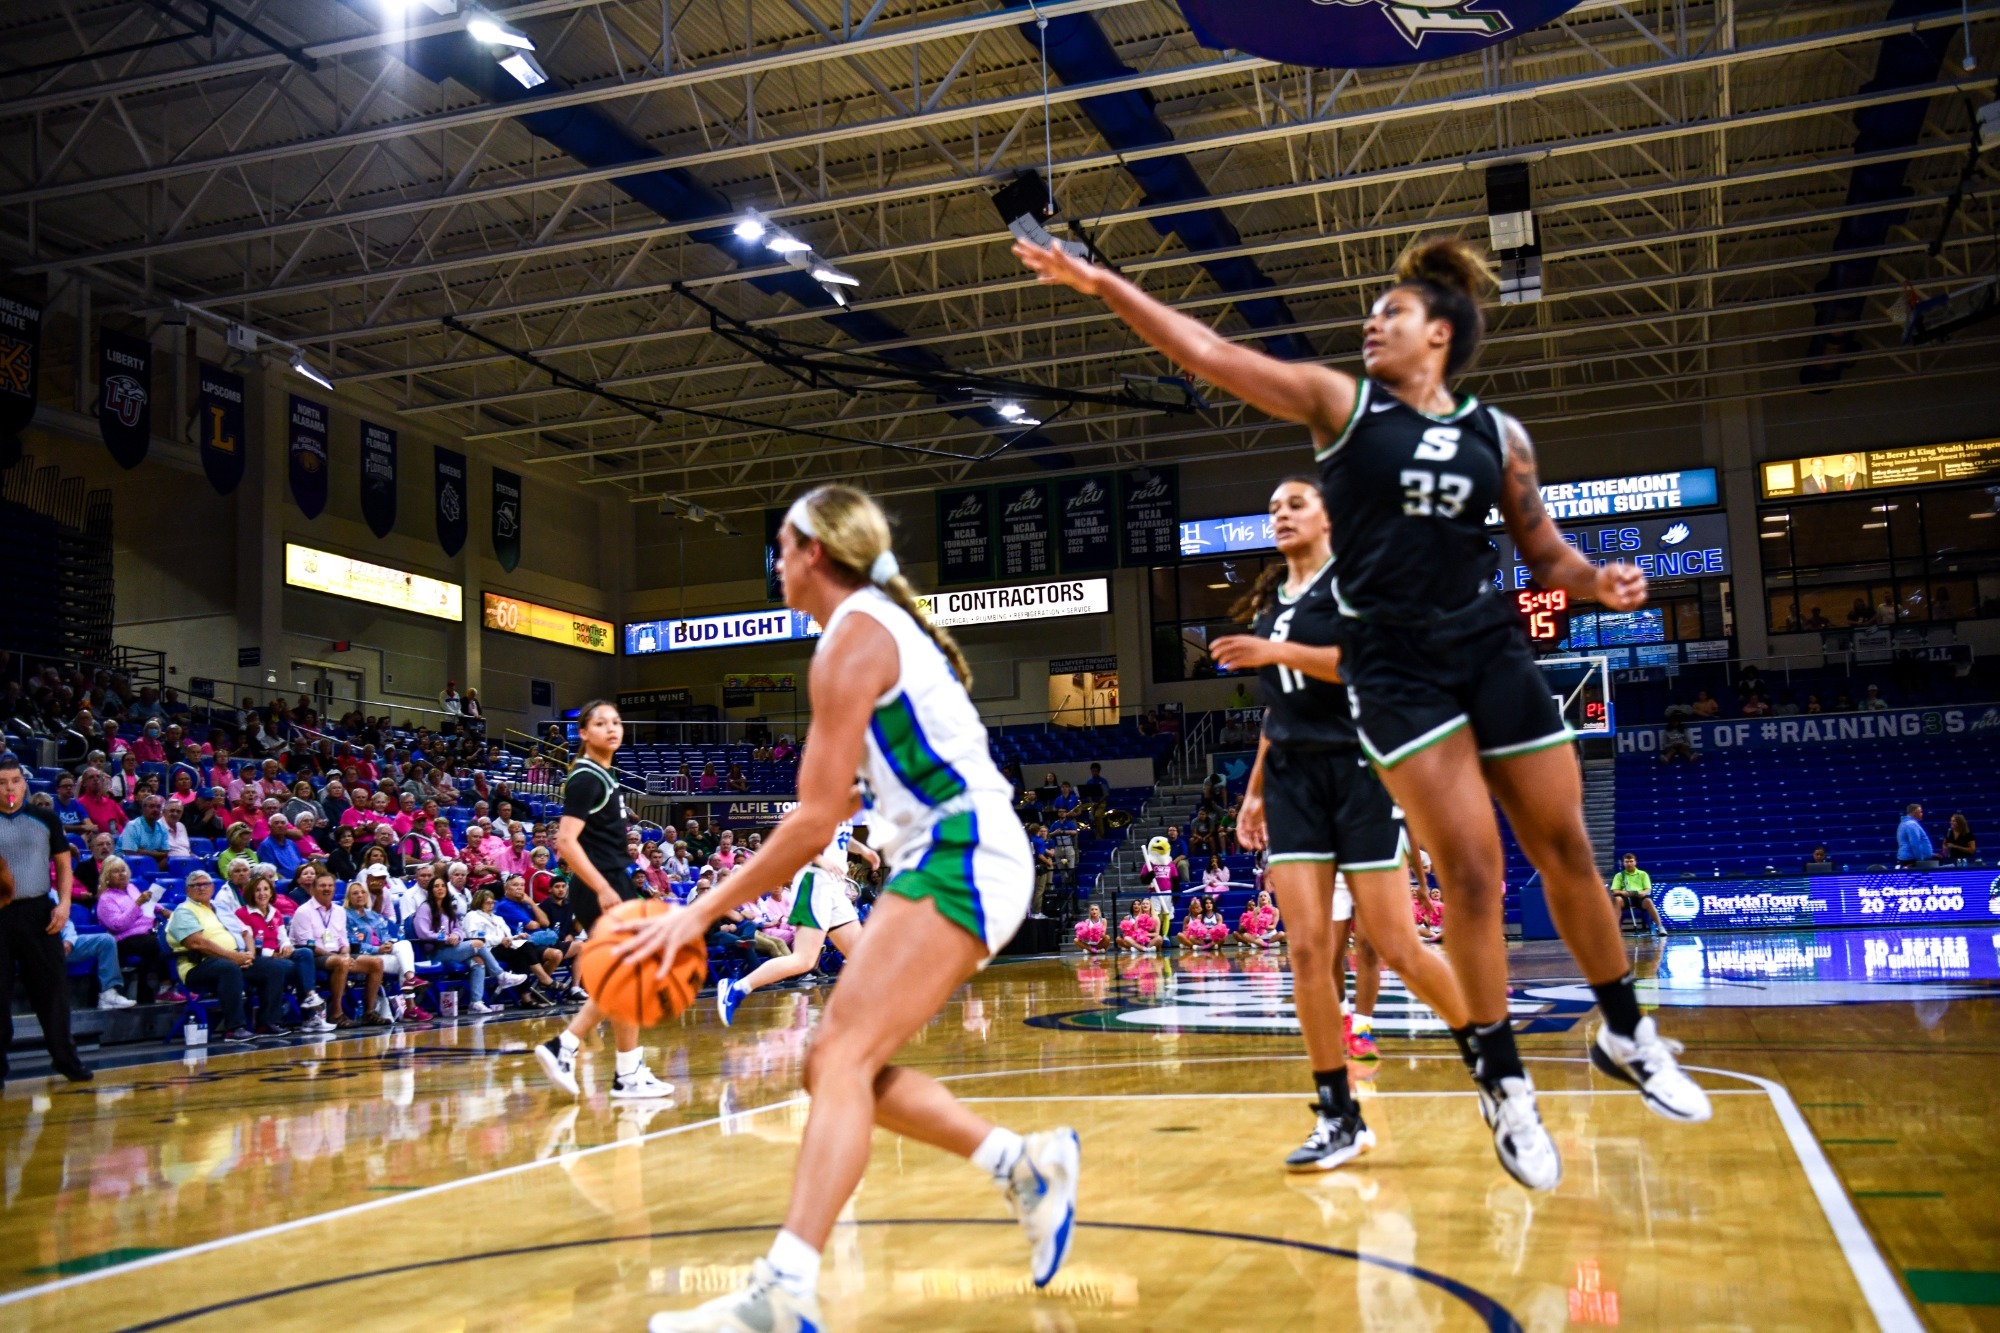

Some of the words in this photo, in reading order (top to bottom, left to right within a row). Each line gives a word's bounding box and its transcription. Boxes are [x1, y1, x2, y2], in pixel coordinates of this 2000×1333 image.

[0, 296, 40, 323] NESAW
[0, 310, 27, 331] TATE
[106, 348, 145, 372] LIBERTY
[202, 380, 242, 404] LIPSCOMB
[297, 403, 321, 421] NORTH
[209, 404, 236, 455] L
[292, 412, 326, 434] ALABAMA
[368, 427, 390, 443] NORTH
[1413, 426, 1462, 461] S
[366, 437, 392, 453] FLORIDA
[1871, 453, 1885, 461] The
[1886, 450, 1908, 460] Berry
[1909, 449, 1916, 457] &
[1917, 447, 1936, 457] King
[1937, 444, 1964, 454] Wealth
[439, 463, 462, 479] QUEENS
[496, 483, 519, 499] STETSON
[1130, 484, 1168, 502] FGCU
[1400, 470, 1474, 519] 33
[1538, 472, 1680, 501] YER-TREMONT
[1768, 488, 1794, 497] Advisors
[1004, 497, 1043, 517] FGCU
[1066, 489, 1105, 510] FGCU
[1614, 490, 1681, 513] SUITE
[947, 503, 982, 521] FGCU
[1138, 509, 1162, 521] NCAA
[1013, 522, 1036, 534] NCAA
[1064, 525, 1109, 537] TOURNAMENT
[1074, 516, 1098, 528] NCAA
[1127, 518, 1173, 530] APPEARANCES
[954, 528, 977, 540] NCAA
[1002, 531, 1047, 544] TOURNAMENT
[1155, 535, 1170, 544] 2017
[1214, 521, 1255, 543] This
[944, 536, 987, 550] TOURNAMENT
[949, 582, 1085, 613] CONTRACTORS
[1519, 590, 1567, 613] 5:49
[497, 601, 518, 629] 60
[935, 617, 969, 627] ELECTRICAL
[976, 613, 1007, 623] PLUMBING
[1066, 605, 1092, 614] SERVICE
[573, 621, 608, 638] CROWTHER
[675, 622, 719, 643] BUD
[723, 616, 786, 637] LIGHT
[1530, 611, 1555, 638] 15
[577, 633, 604, 647] ROOFING
[1628, 669, 1649, 683] LL
[620, 695, 646, 705] BEER
[650, 695, 655, 703] &
[659, 692, 686, 702] WINE
[1616, 724, 1703, 754] HOE
[1713, 722, 1751, 748] OF
[1760, 710, 1965, 744] #RAINING3S
[729, 801, 769, 813] ALFIE
[1933, 884, 1962, 895] from
[1860, 898, 1885, 913] 20
[1898, 894, 1965, 914] 20,000
